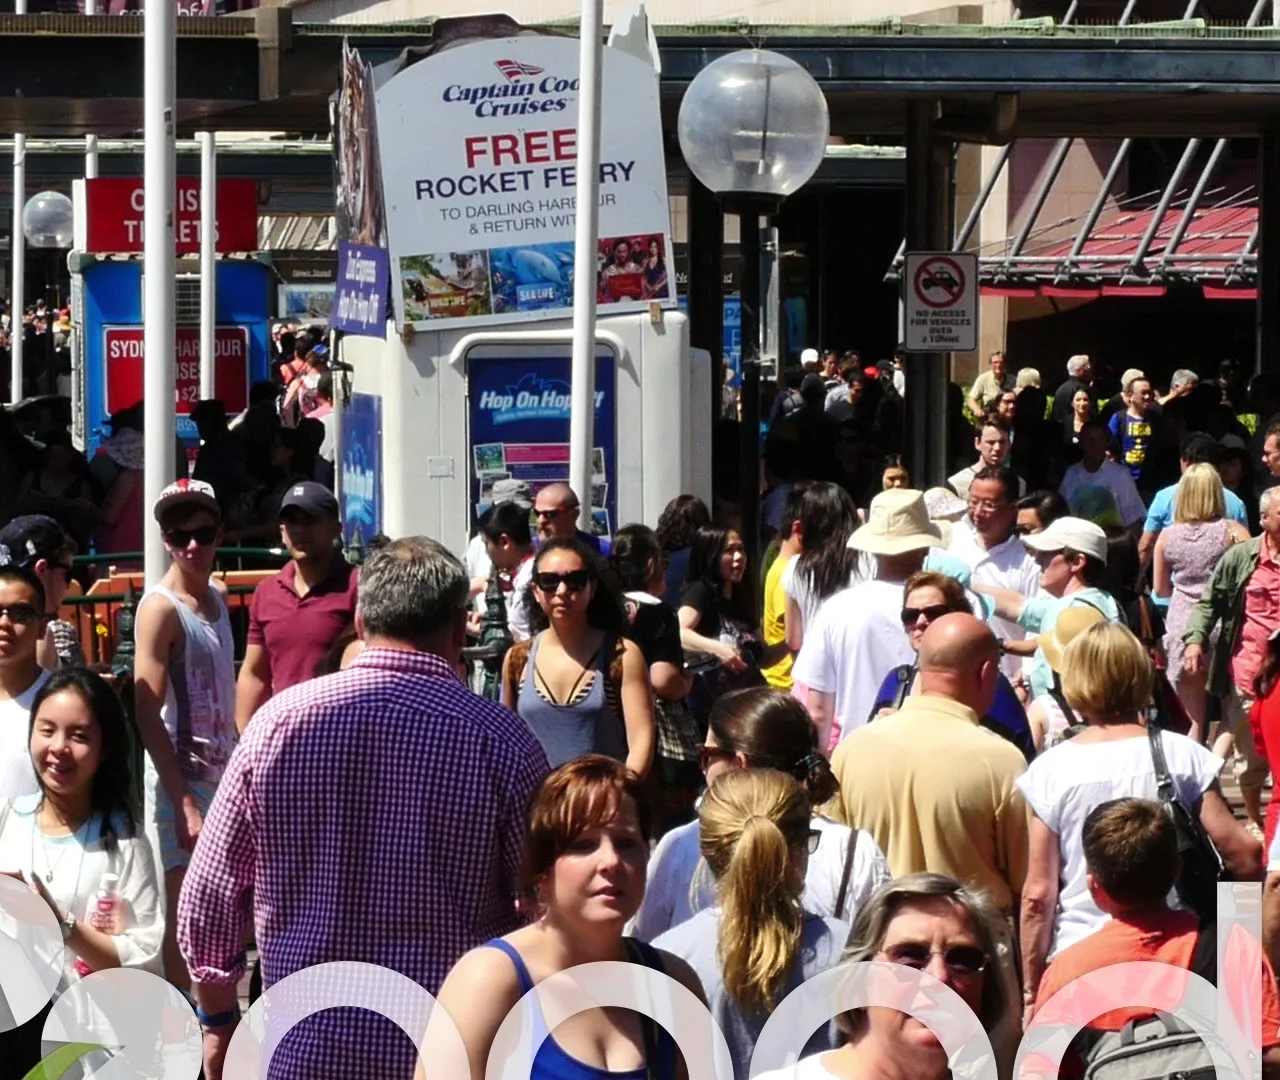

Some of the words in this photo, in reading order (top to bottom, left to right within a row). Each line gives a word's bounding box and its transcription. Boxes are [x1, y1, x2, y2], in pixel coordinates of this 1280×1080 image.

[442, 80, 535, 104] Captain
[539, 76, 581, 93] Coo
[475, 97, 567, 118] Cruises
[465, 129, 578, 169] FREE
[416, 170, 534, 200] ROCKET
[544, 161, 635, 189] FERY
[131, 189, 202, 211] CIS
[440, 207, 460, 220] TO
[466, 200, 534, 219] DARLING
[469, 224, 479, 235] &
[484, 217, 546, 234] RETURN
[551, 214, 577, 228] WIT
[176, 339, 241, 356] HAROUR
[929, 335, 959, 343] TONNE
[479, 391, 514, 411] Hop
[516, 391, 539, 408] On
[541, 390, 572, 411] Hop
